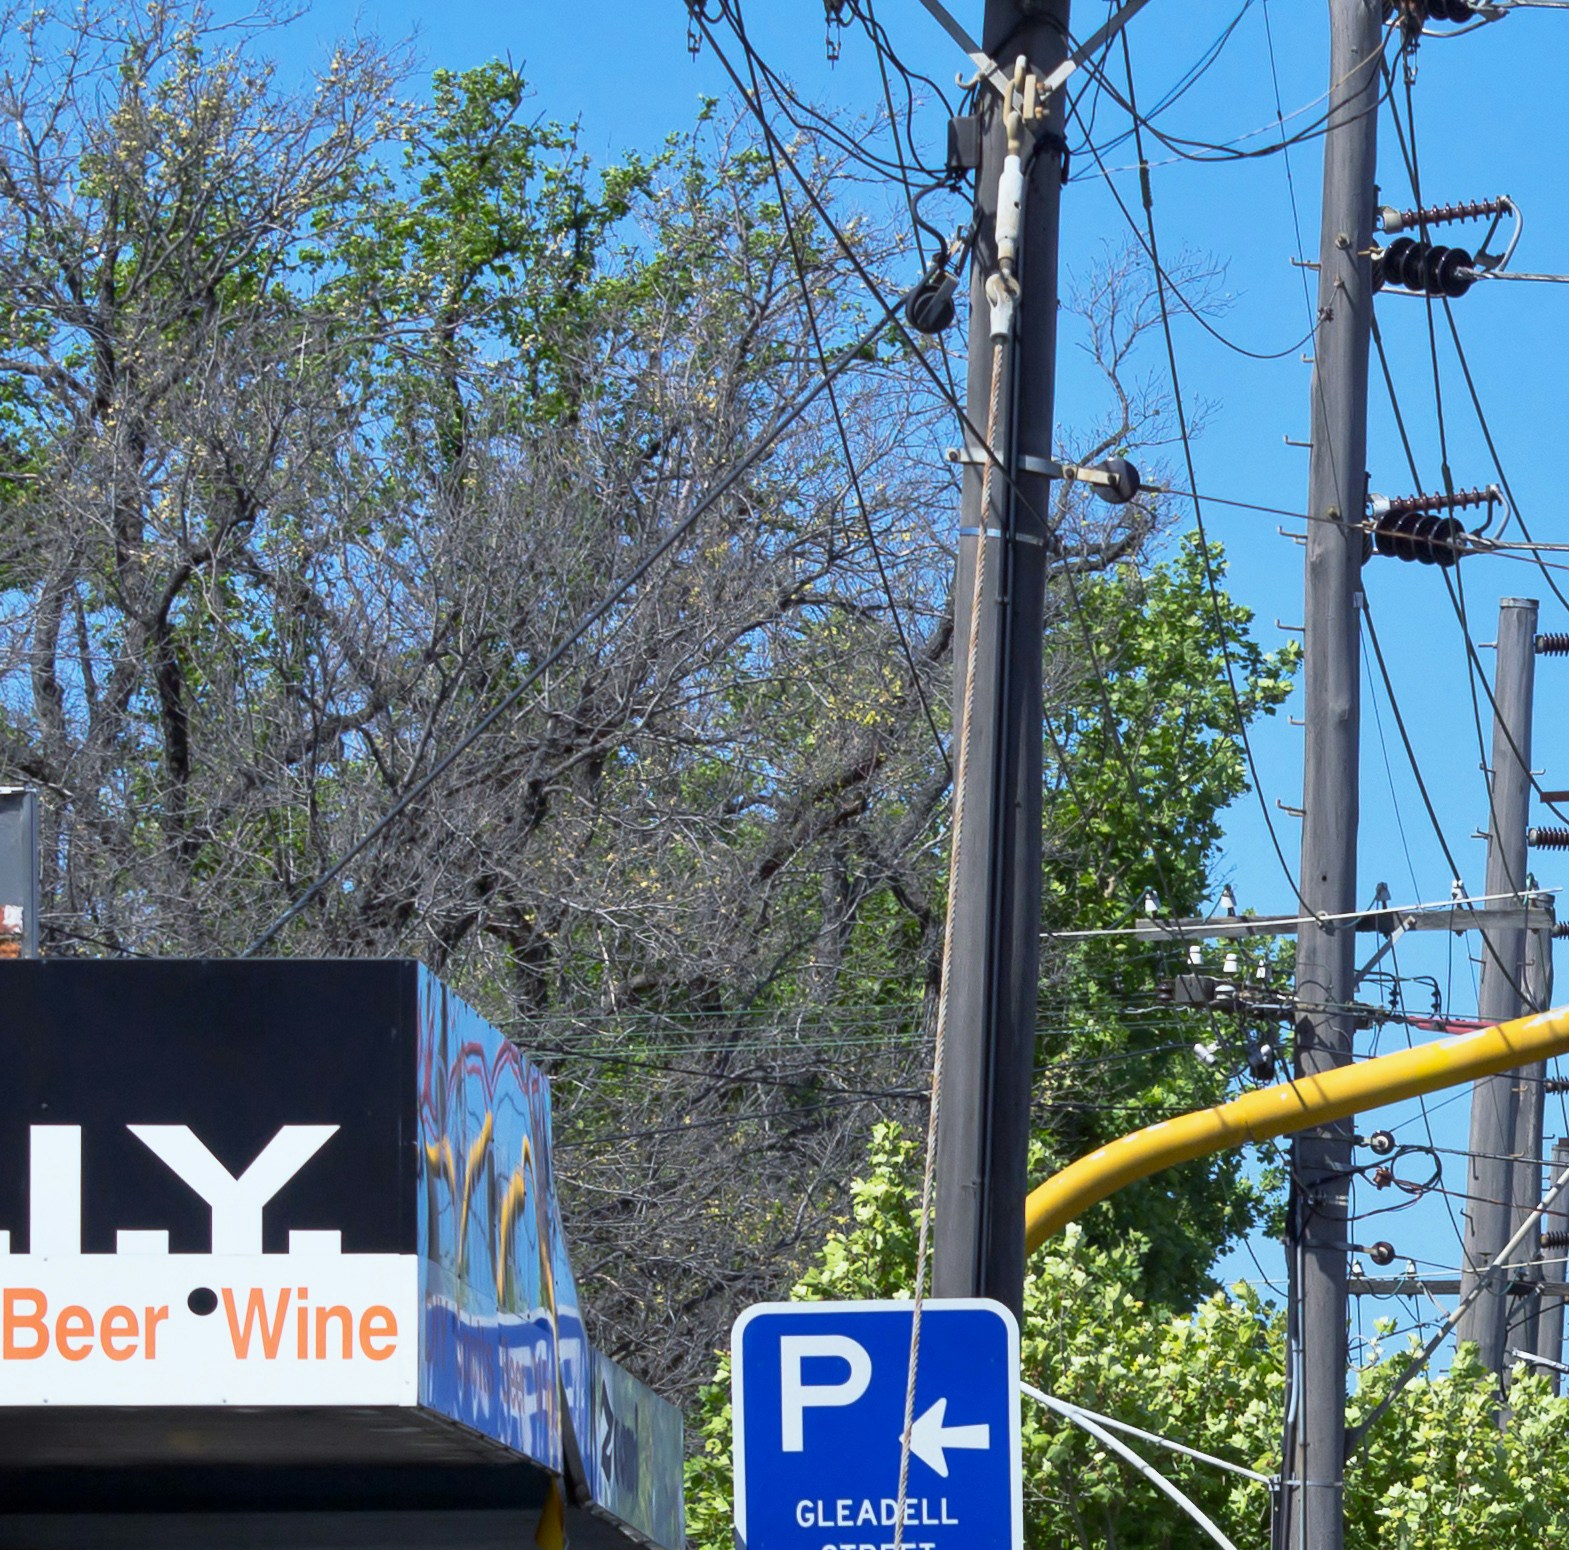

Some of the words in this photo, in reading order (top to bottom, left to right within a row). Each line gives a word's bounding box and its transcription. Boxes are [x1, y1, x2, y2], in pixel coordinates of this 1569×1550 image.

[3, 1287, 169, 1361] Beer
[220, 1286, 398, 1361] Wine
[780, 1335, 872, 1452] P
[796, 1498, 959, 1528] GLEADELL
